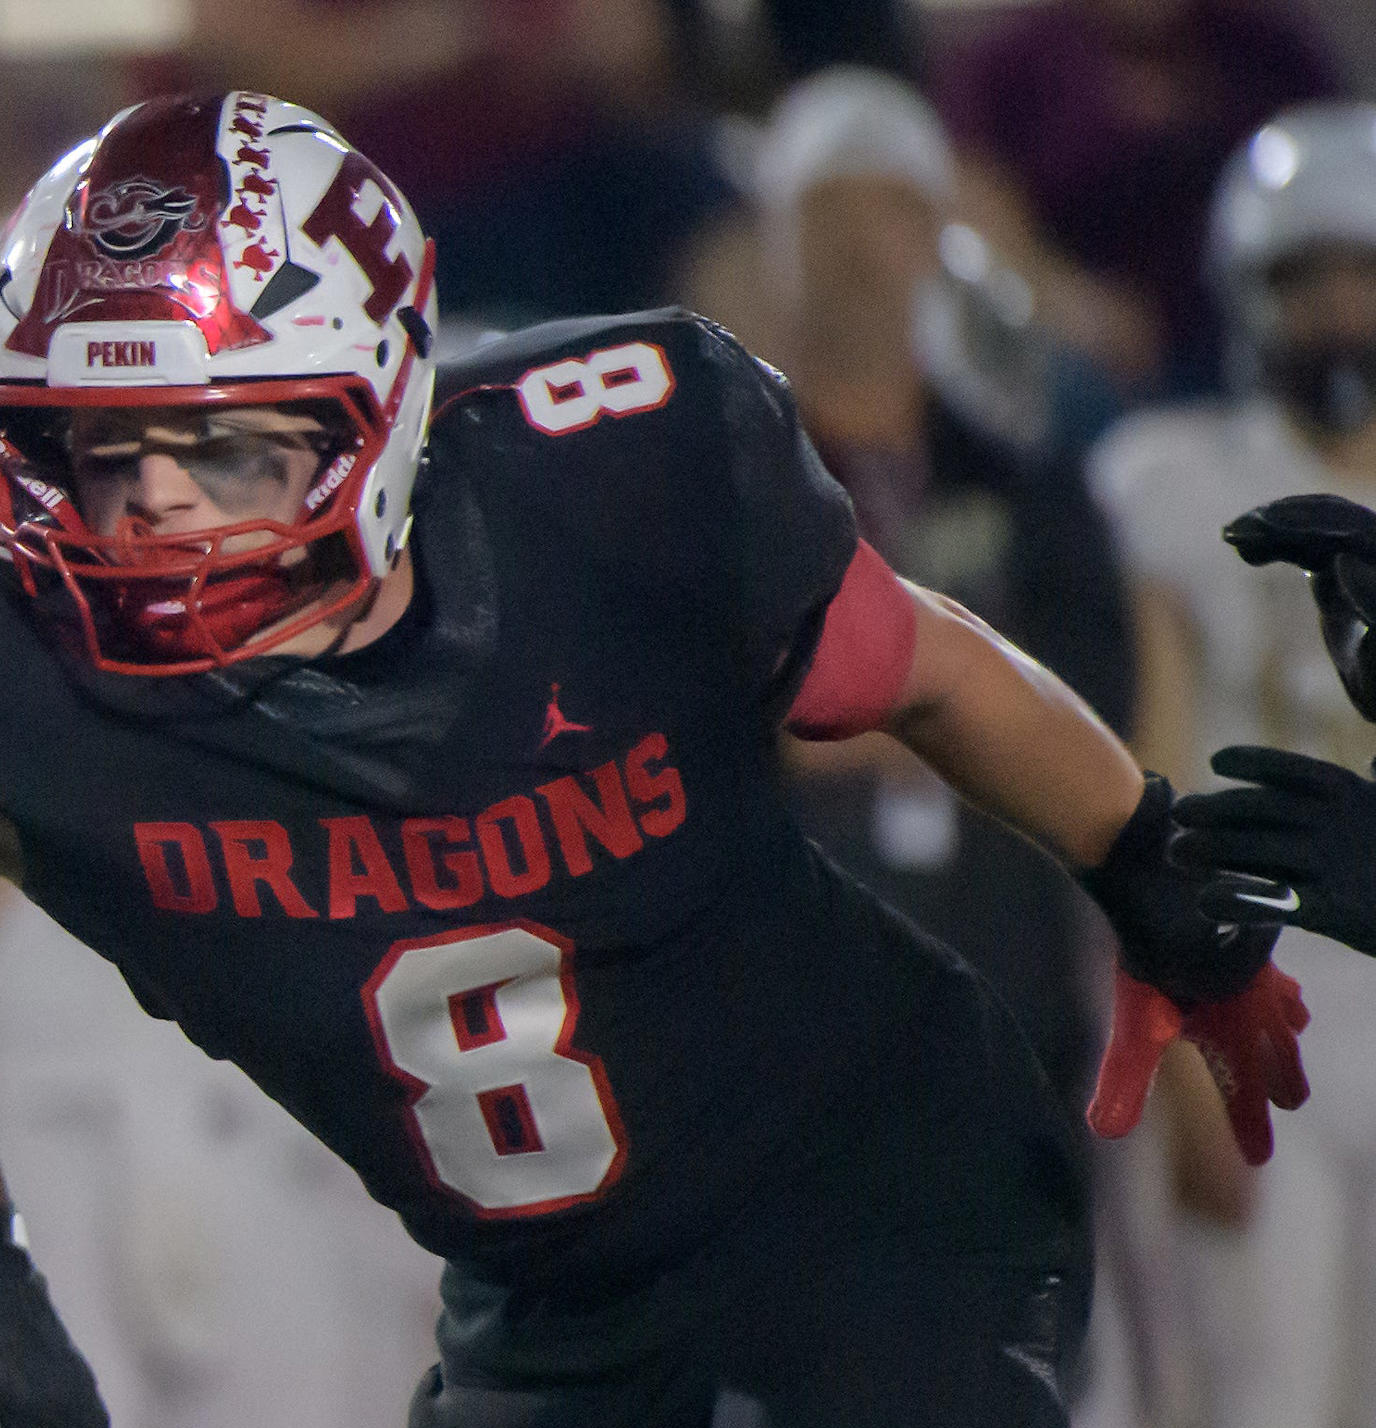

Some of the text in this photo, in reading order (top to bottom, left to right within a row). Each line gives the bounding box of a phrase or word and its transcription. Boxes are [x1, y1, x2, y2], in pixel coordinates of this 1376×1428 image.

[87, 340, 156, 367] PEKIN
[517, 342, 678, 437] 8
[305, 454, 357, 511] Ridd
[133, 732, 689, 921] DRAGONS
[360, 920, 630, 1222] 8
